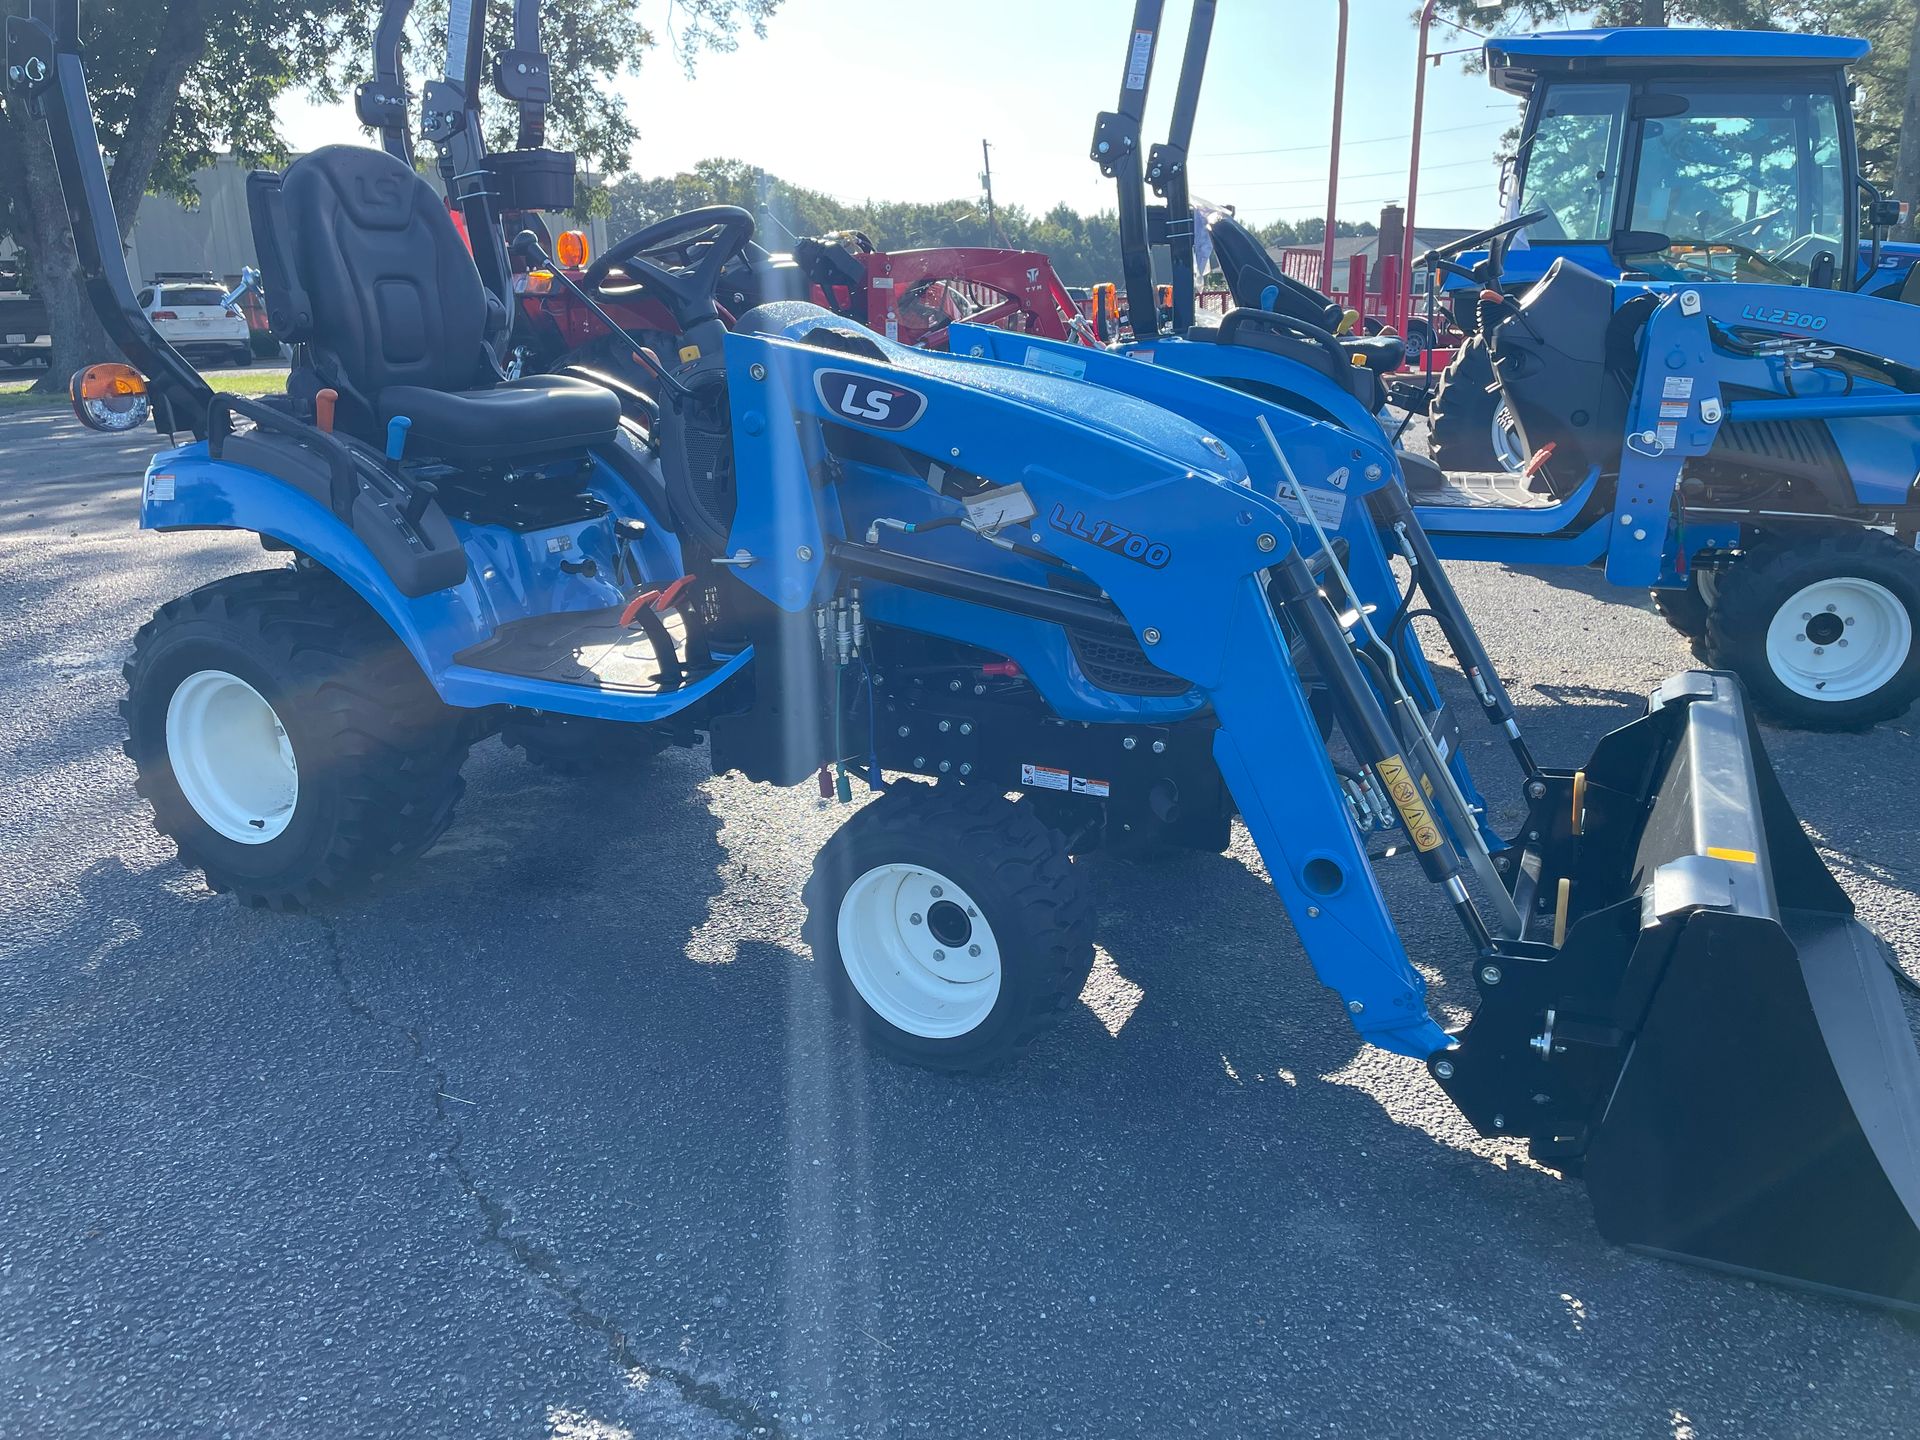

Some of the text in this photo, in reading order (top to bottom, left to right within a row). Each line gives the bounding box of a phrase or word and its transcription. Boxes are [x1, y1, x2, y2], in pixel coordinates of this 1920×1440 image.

[354, 174, 403, 209] LS
[1025, 284, 1043, 293] TYM
[1741, 304, 1828, 331] LL2300
[840, 383, 894, 421] LS
[1049, 502, 1173, 571] LL1700
